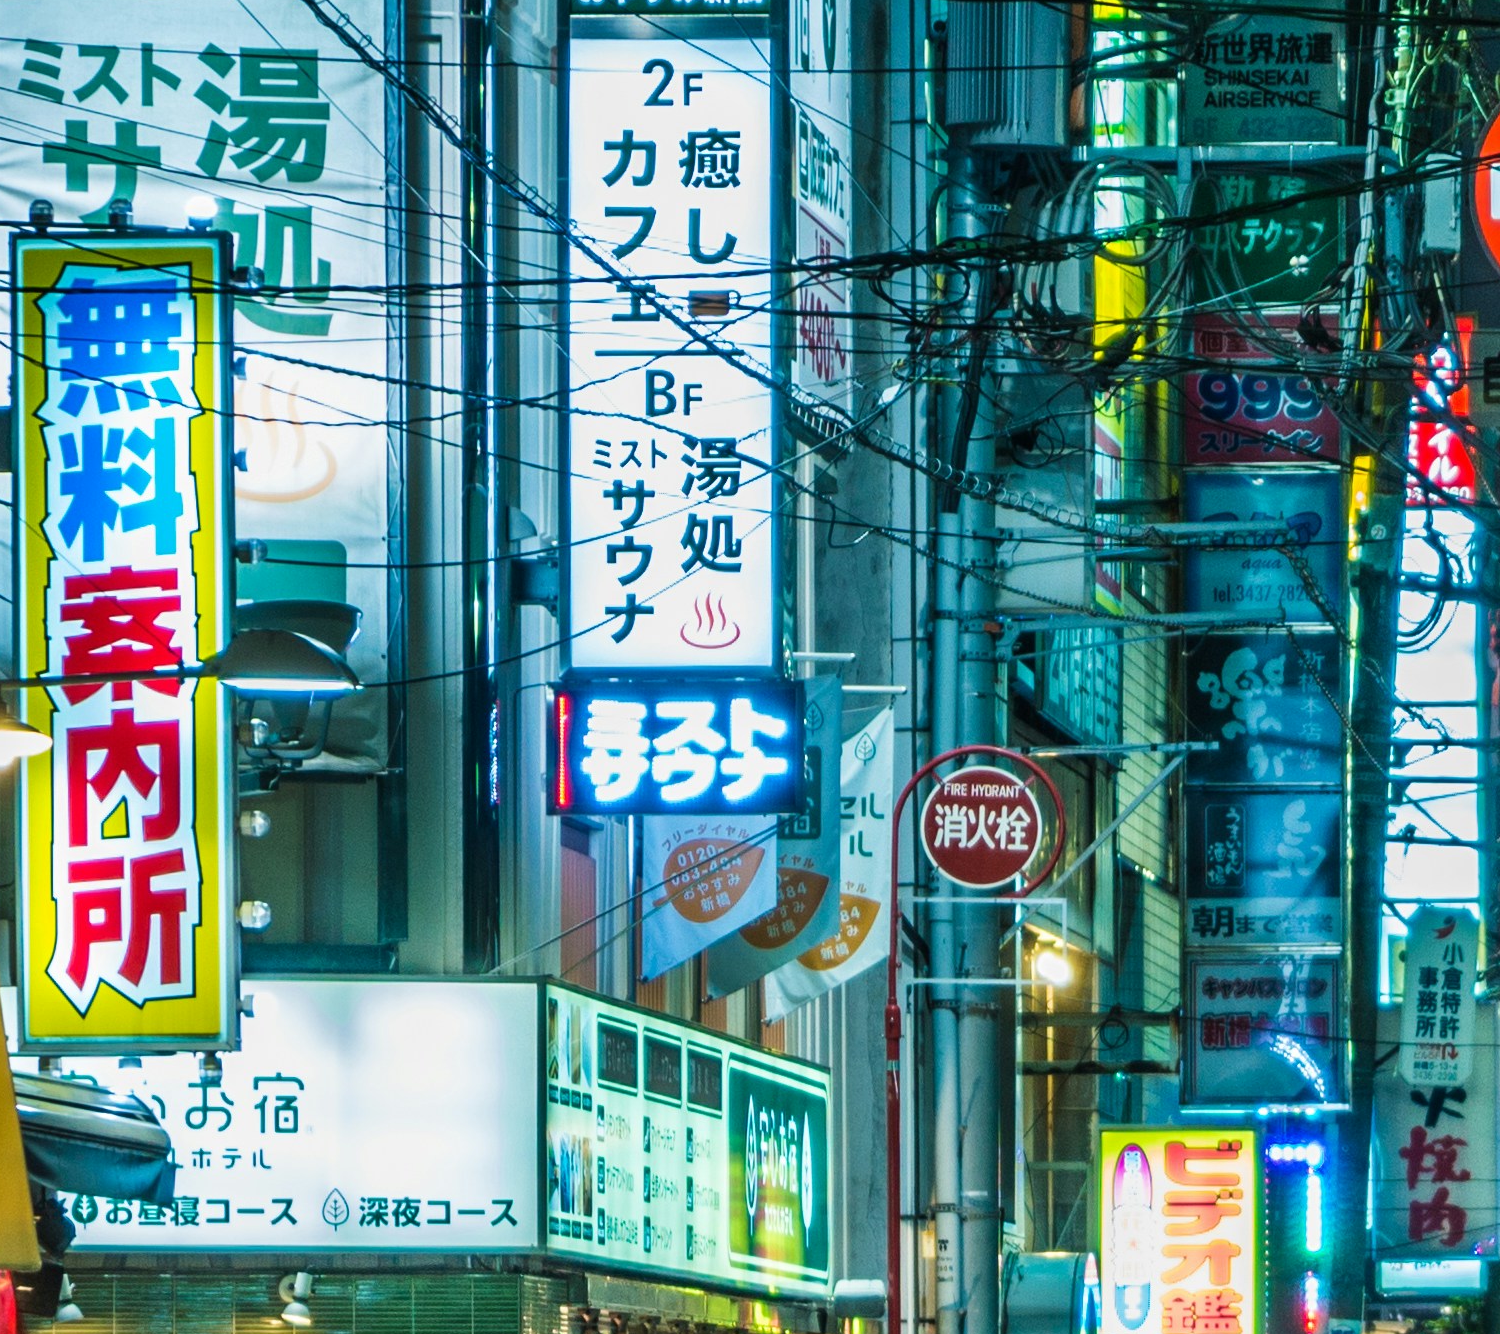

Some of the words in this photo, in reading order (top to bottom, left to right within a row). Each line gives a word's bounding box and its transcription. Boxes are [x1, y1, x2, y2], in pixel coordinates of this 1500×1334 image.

[18, 38, 182, 107] ミスト
[640, 57, 704, 108] 2F
[1203, 68, 1311, 86] SHINSEKAI
[1203, 89, 1322, 108] AIRSERVICE
[678, 126, 742, 267] 癒し
[601, 127, 661, 325] カフェ
[644, 368, 704, 419] BF
[1198, 372, 1324, 422] 999
[592, 437, 669, 471] ミスト
[1198, 428, 1325, 455] スリーナイン
[679, 435, 745, 576] 湯処
[602, 477, 658, 644] サウナ
[56, 275, 189, 992] 無料案内所
[586, 697, 788, 753] ミスト
[582, 746, 790, 804] サウナ
[944, 781, 969, 798] FIRE
[971, 781, 1022, 800] HYDRANT
[661, 821, 751, 853] フリーダイヤル
[933, 803, 1034, 855] 消火栓
[682, 872, 742, 902] おやすみ
[699, 891, 731, 913] 新橋
[766, 919, 797, 940] 新橋
[819, 942, 851, 962] 新橋
[1414, 966, 1439, 1039] 事務所
[1439, 941, 1465, 1040] 小倉特許
[759, 1107, 798, 1195] 安心お宿
[104, 1195, 299, 1228] お昼寝コース
[358, 1195, 519, 1228] 深夜コース
[1398, 1124, 1472, 1248] 焼肉
